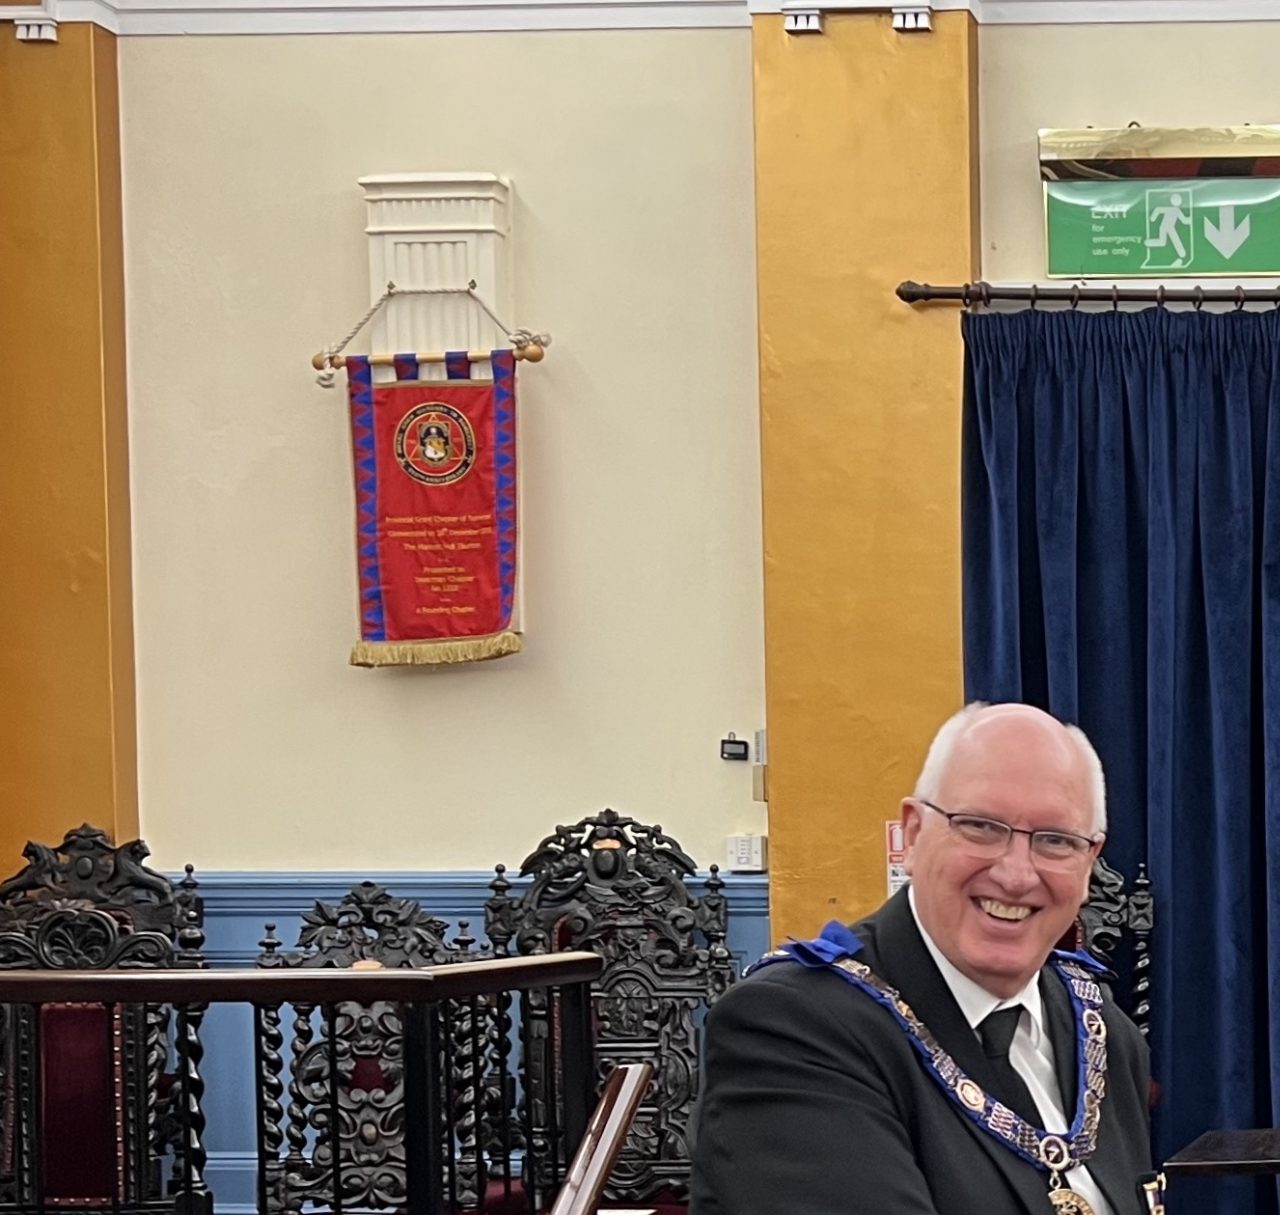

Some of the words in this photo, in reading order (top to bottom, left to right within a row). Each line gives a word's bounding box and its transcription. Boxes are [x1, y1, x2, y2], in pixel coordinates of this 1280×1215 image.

[1091, 223, 1105, 232] for
[1091, 236, 1142, 245] emergency
[1091, 248, 1108, 256] use
[1111, 246, 1130, 256] only
